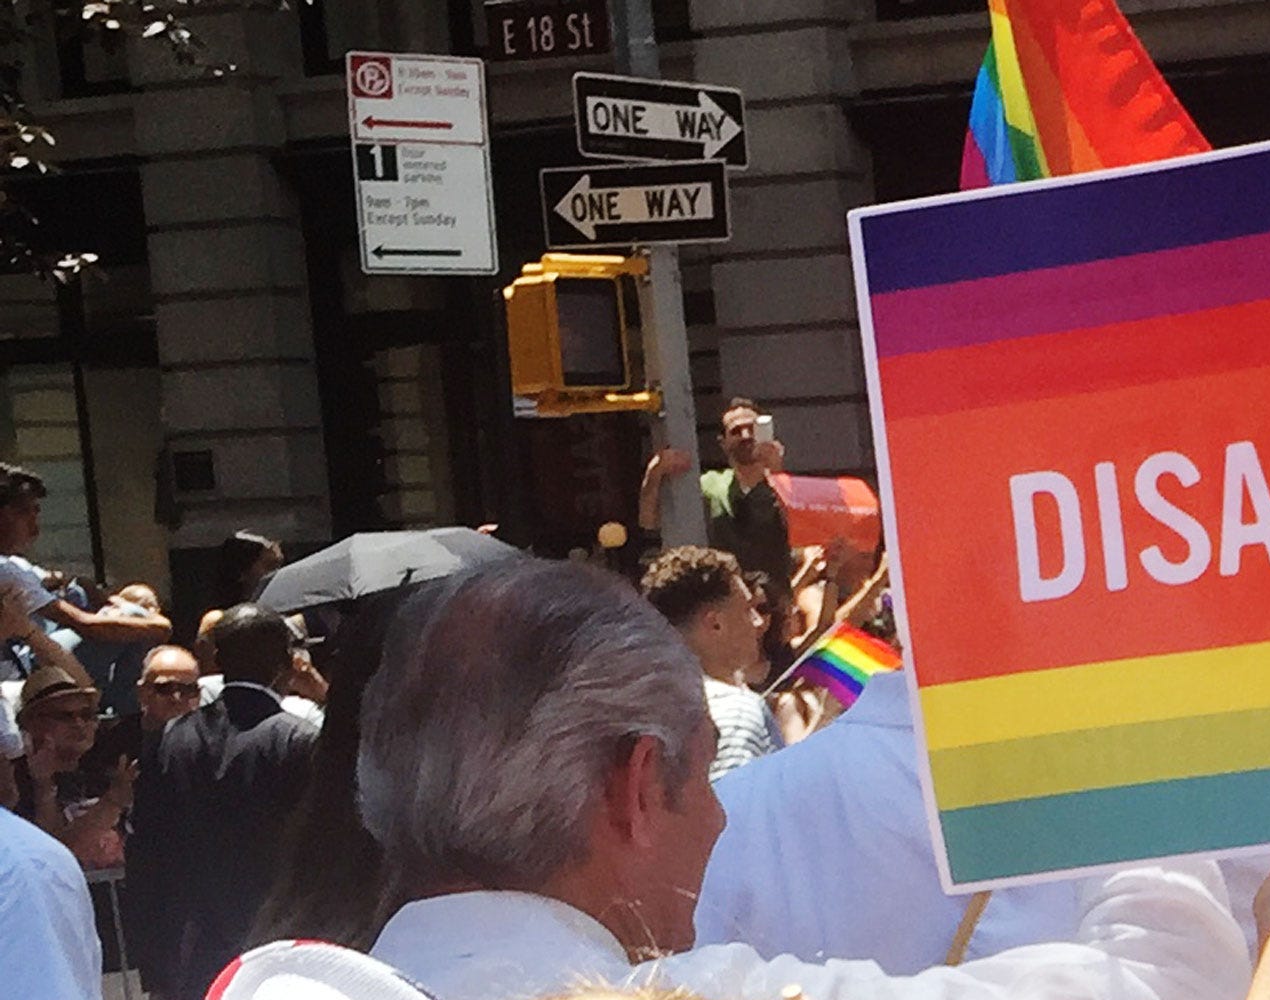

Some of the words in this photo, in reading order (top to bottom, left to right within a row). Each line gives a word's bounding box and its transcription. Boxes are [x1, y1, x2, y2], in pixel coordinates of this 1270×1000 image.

[502, 19, 516, 54] E
[527, 15, 555, 52] 18
[566, 12, 594, 50] St
[592, 102, 649, 136] ONE
[675, 109, 727, 141] WAY
[369, 144, 384, 178] 1
[570, 191, 621, 222] ONE
[644, 187, 701, 219] WAY
